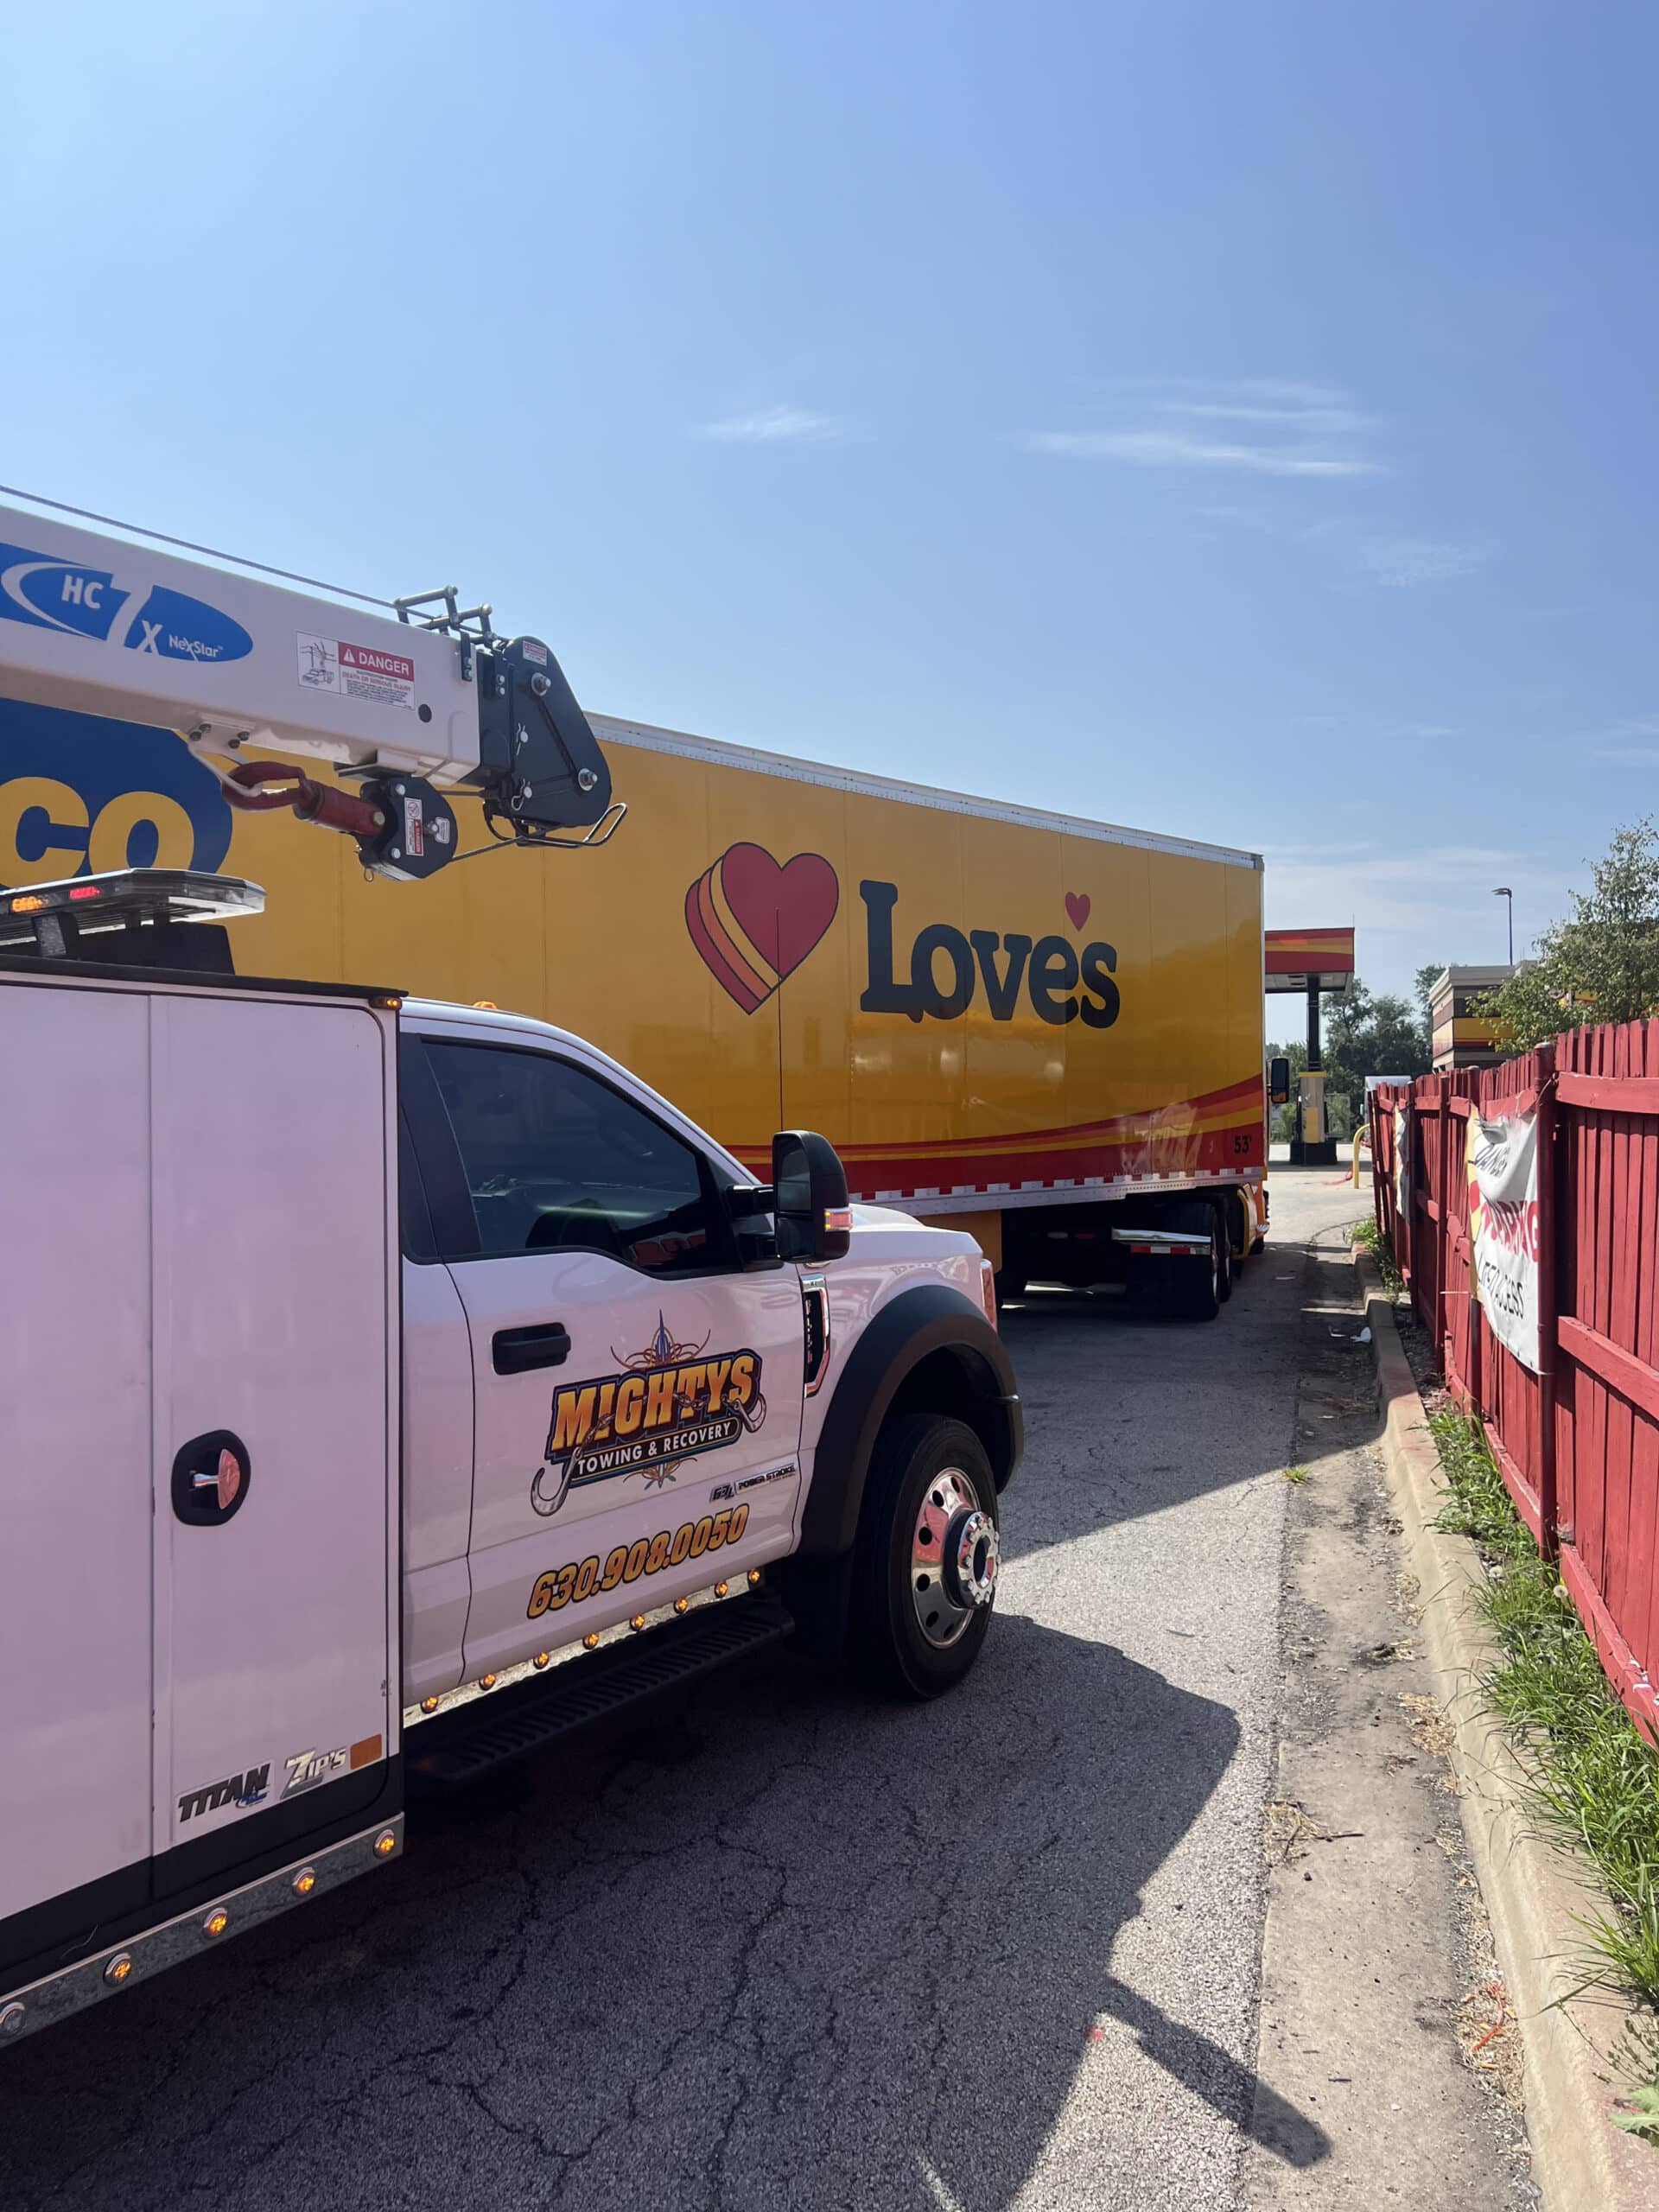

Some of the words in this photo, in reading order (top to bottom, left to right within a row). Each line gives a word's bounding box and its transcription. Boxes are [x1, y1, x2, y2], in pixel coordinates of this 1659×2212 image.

[61, 574, 104, 609] HC
[359, 652, 410, 676] DANGER
[578, 1445, 642, 1475] TOWING
[648, 1443, 658, 1457] &
[664, 1422, 731, 1452] RECOVERY
[526, 1503, 749, 1619] 630.908.0050
[178, 1763, 270, 1822] TITAN
